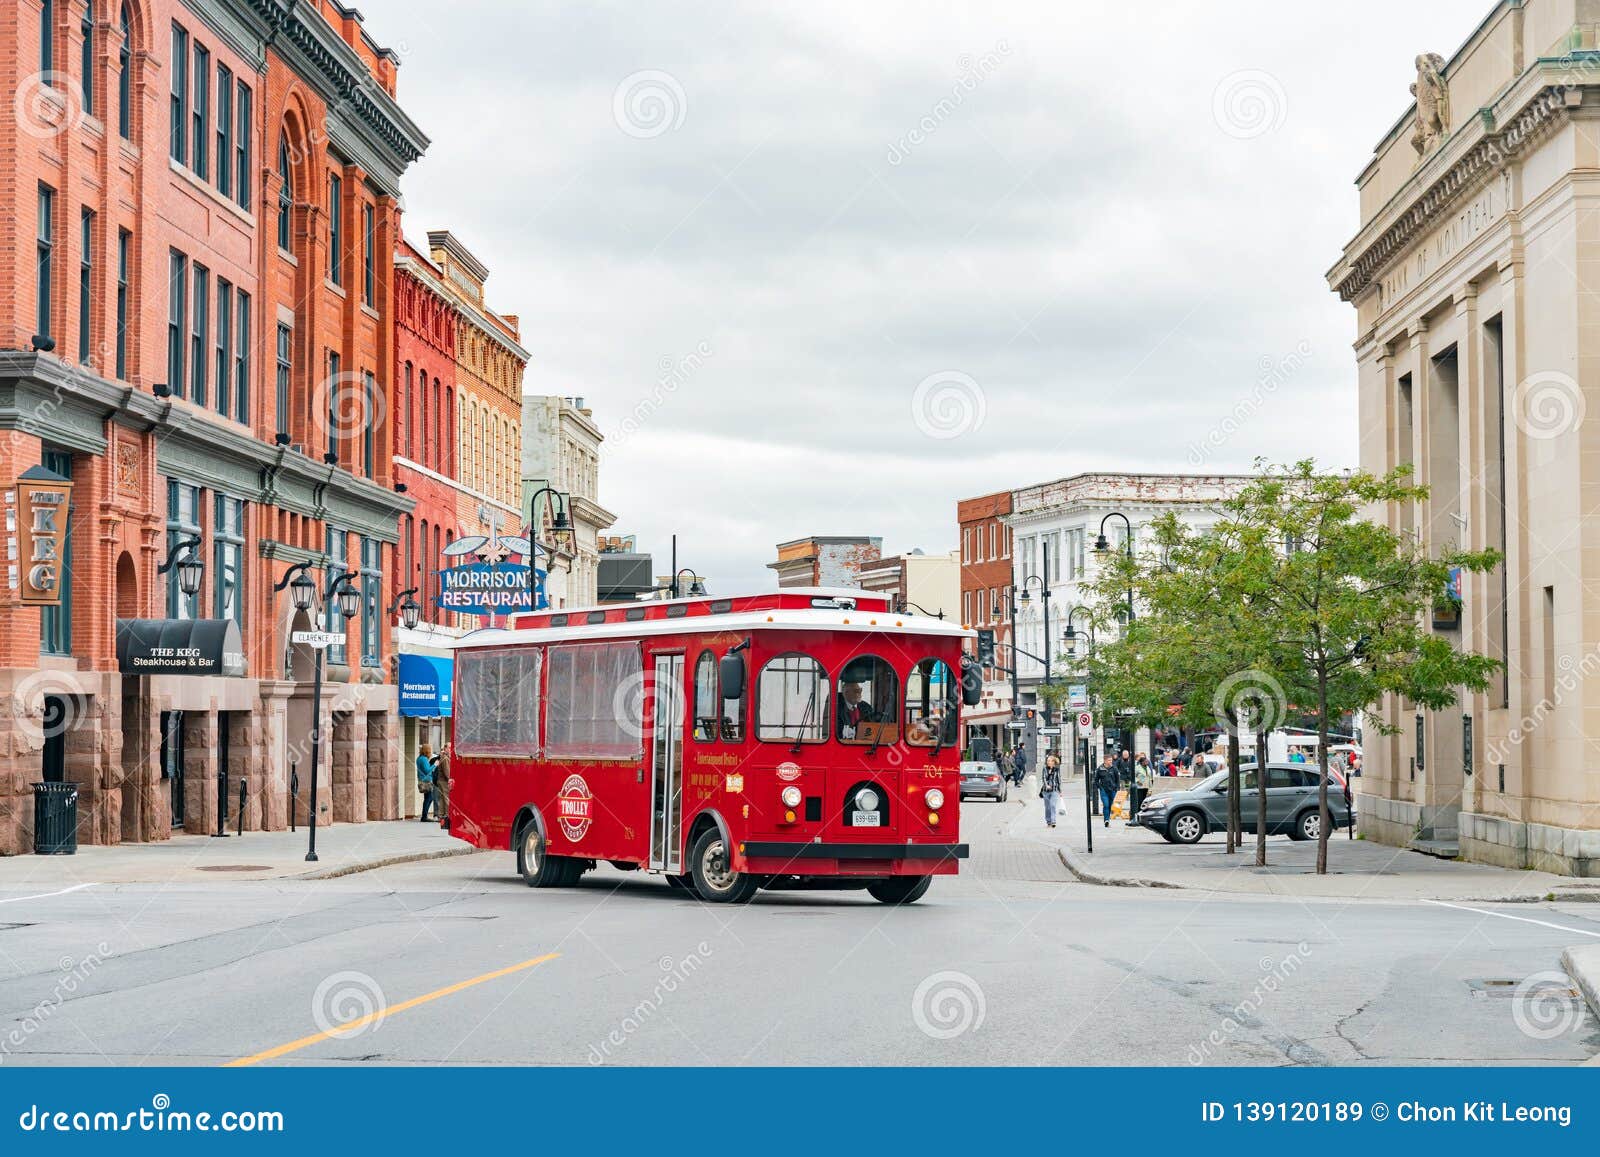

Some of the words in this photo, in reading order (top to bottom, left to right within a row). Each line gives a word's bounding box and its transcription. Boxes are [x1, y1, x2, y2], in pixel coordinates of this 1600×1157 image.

[1417, 249, 1427, 278] OF
[1436, 191, 1494, 257] MONTREAL
[298, 633, 329, 643] CLARENCE
[150, 647, 174, 657] THE
[176, 648, 200, 657] KEG
[133, 657, 187, 667] Steakhouse
[188, 658, 197, 667] &
[198, 658, 215, 667] Bar
[403, 683, 436, 692] Morrison's
[402, 692, 436, 701] Restaurant
[923, 764, 943, 779] 704
[561, 800, 589, 816] TROLLEY
